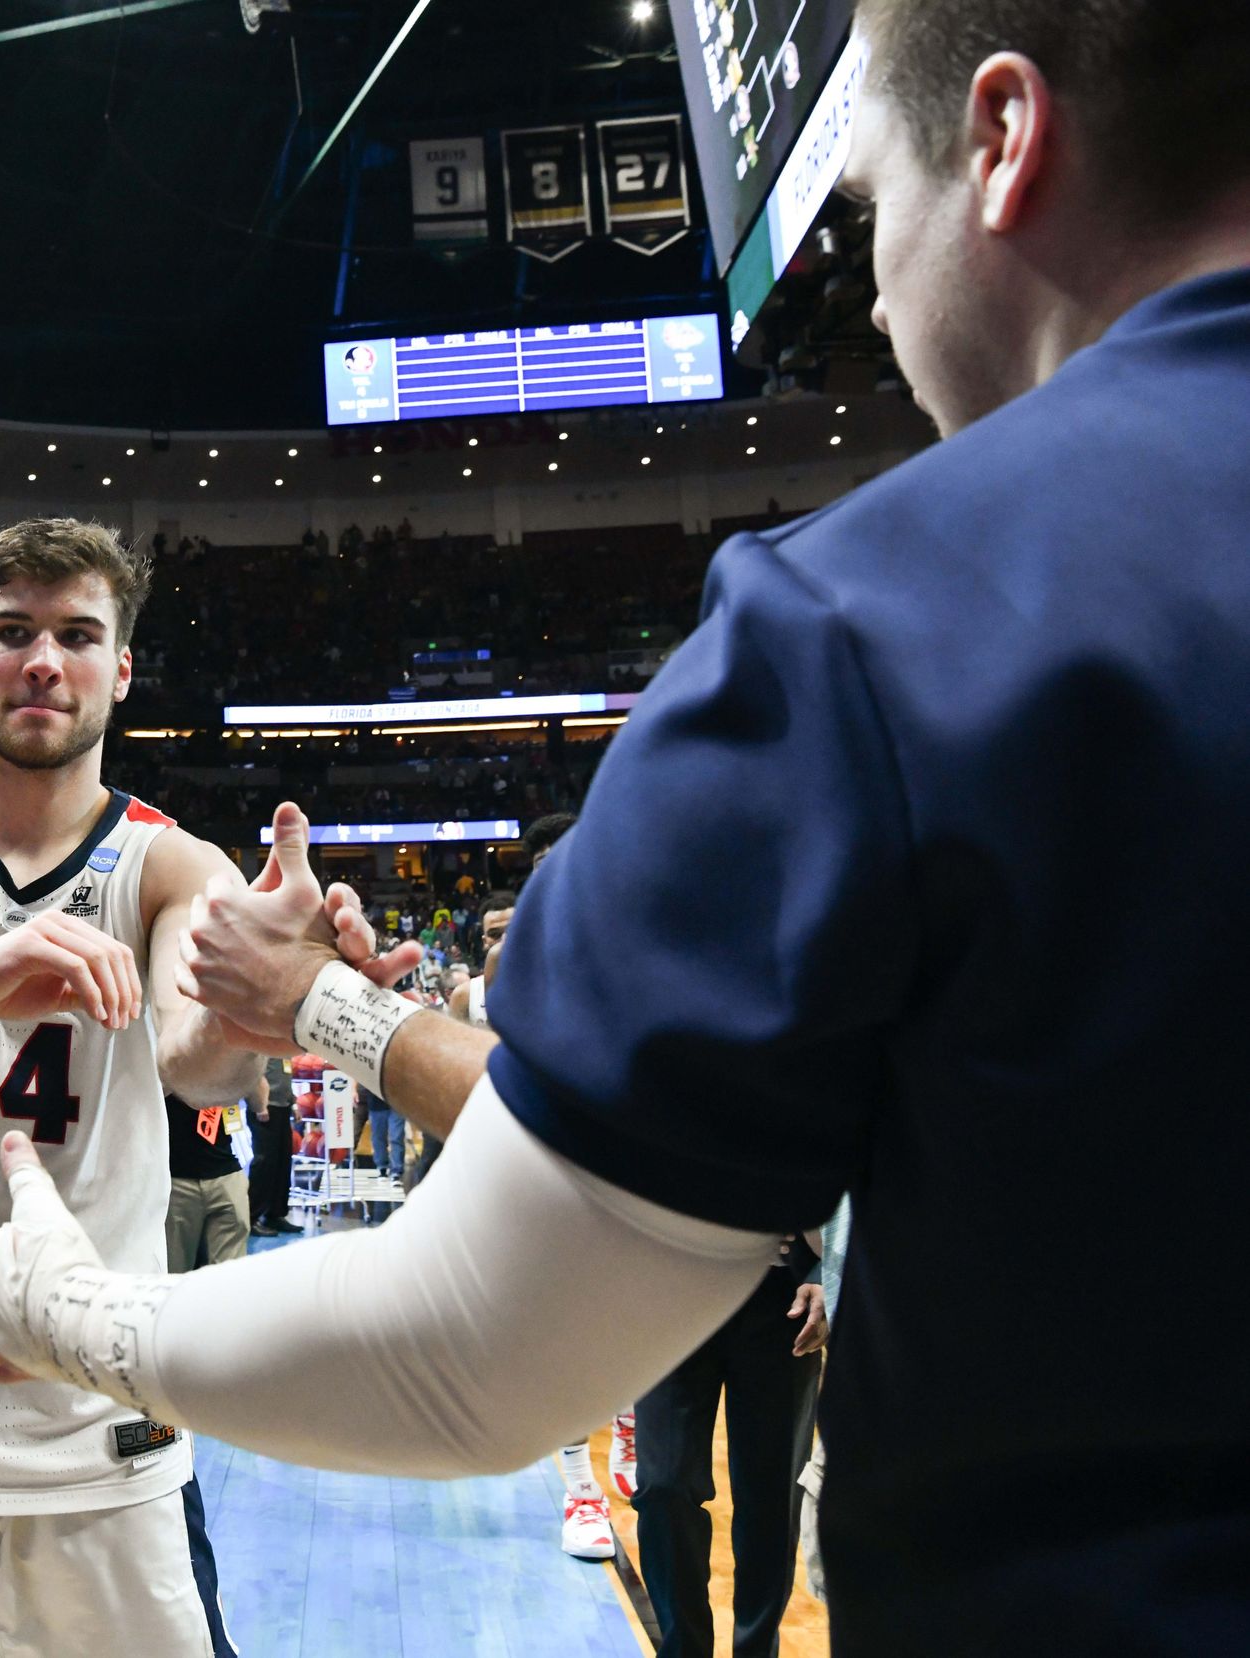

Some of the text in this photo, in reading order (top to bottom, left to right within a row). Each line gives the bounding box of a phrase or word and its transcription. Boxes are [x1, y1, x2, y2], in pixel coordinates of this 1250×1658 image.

[435, 166, 459, 206] 9
[531, 161, 560, 200] 8
[615, 152, 671, 192] 27
[329, 707, 373, 719] FLORIDA
[335, 1106, 343, 1138] Wilson
